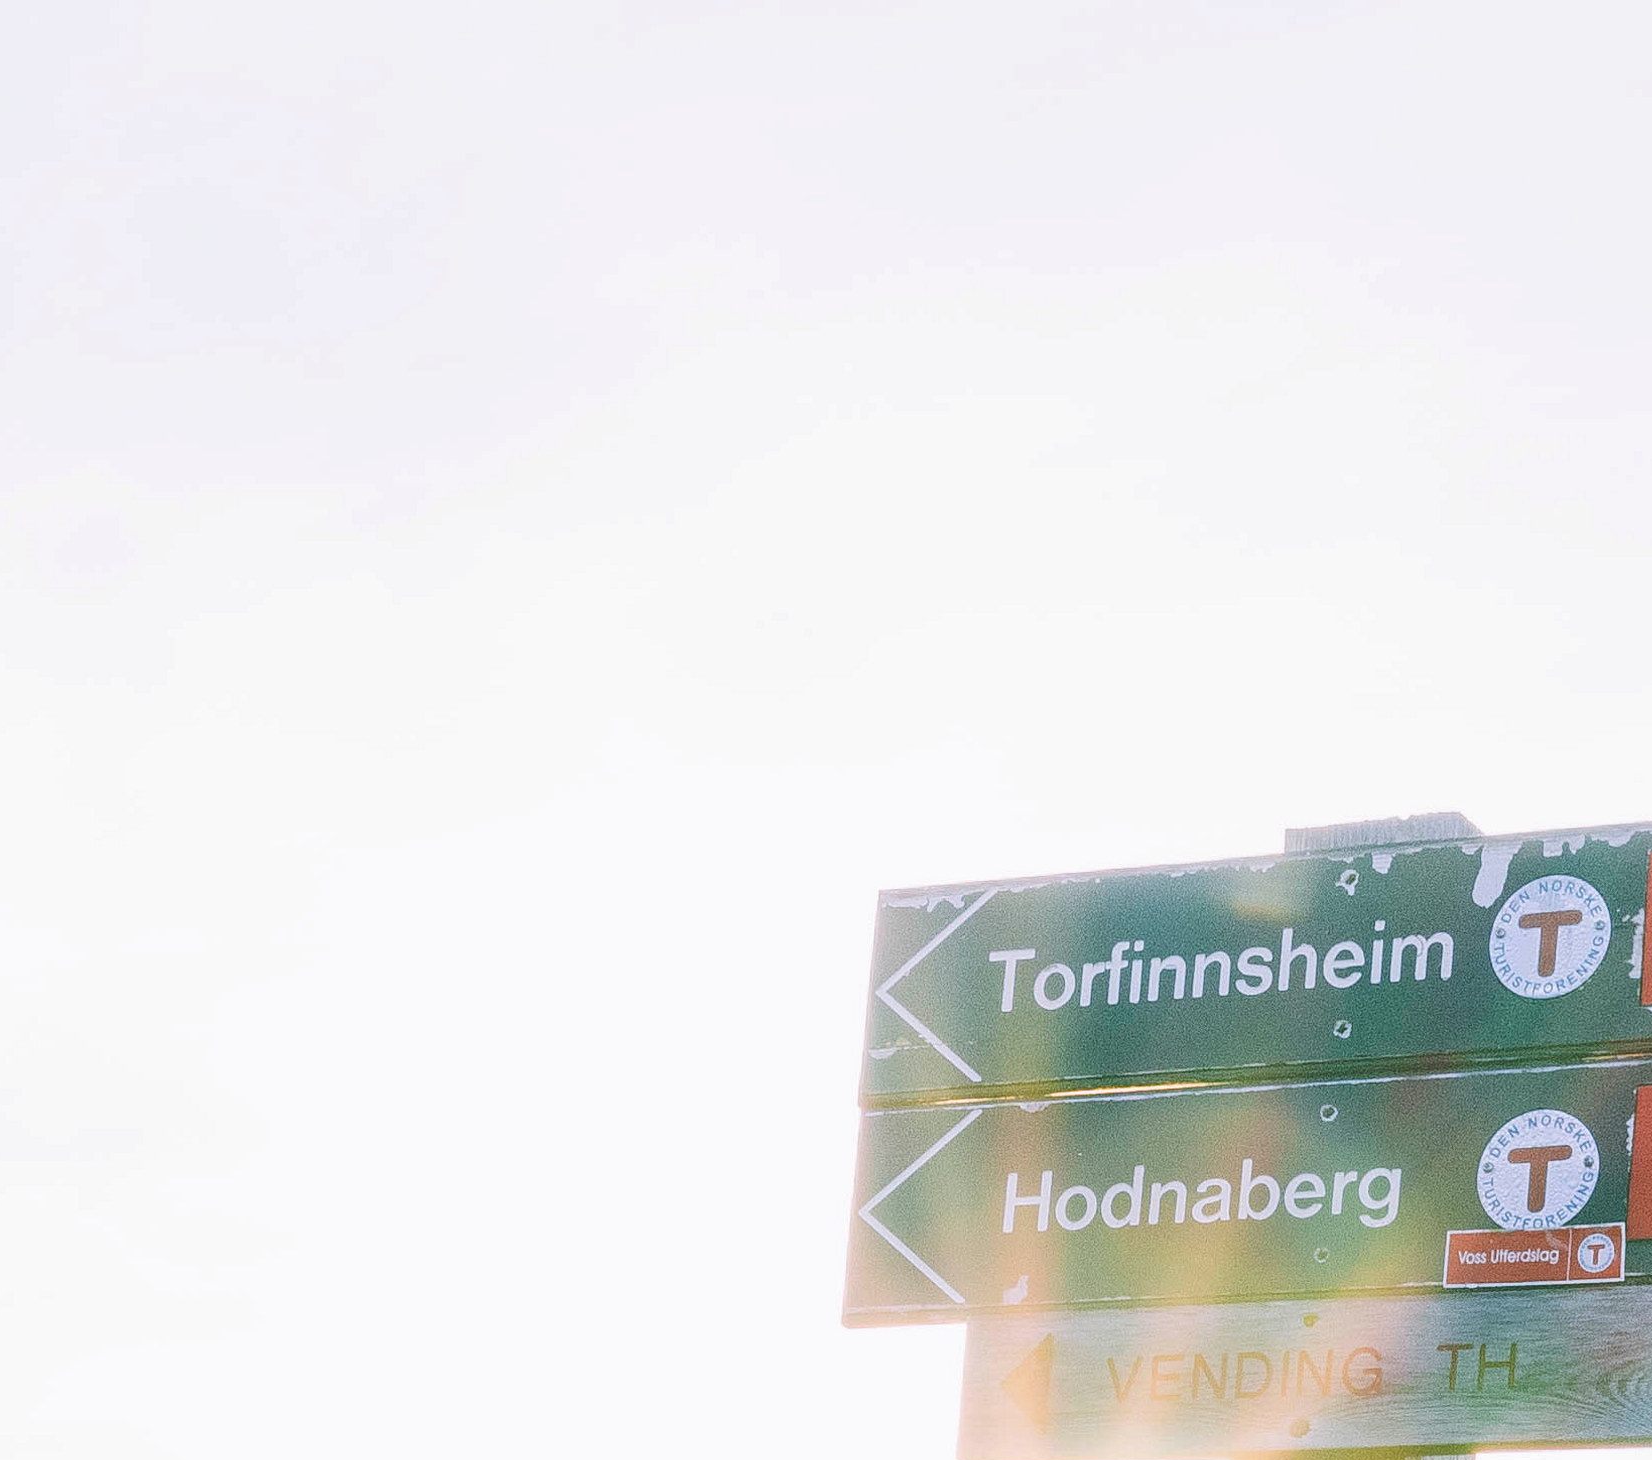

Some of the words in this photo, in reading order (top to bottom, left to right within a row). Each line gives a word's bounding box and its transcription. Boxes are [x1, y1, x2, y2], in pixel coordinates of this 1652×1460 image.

[1502, 891, 1531, 925] DEN
[1539, 878, 1603, 918] NORSKE
[989, 920, 1455, 1012] Torfinnsheim
[1491, 936, 1605, 995] TURISTFORENING
[1519, 909, 1583, 977] T
[1491, 1124, 1520, 1158] DEN
[1528, 1114, 1593, 1152] NORSKE
[1002, 1159, 1402, 1233] Hodnaberg
[1508, 1145, 1573, 1213] T
[1458, 1250, 1487, 1265] Voss
[1107, 1346, 1384, 1404] VENDING
[1437, 1341, 1519, 1391] TH
